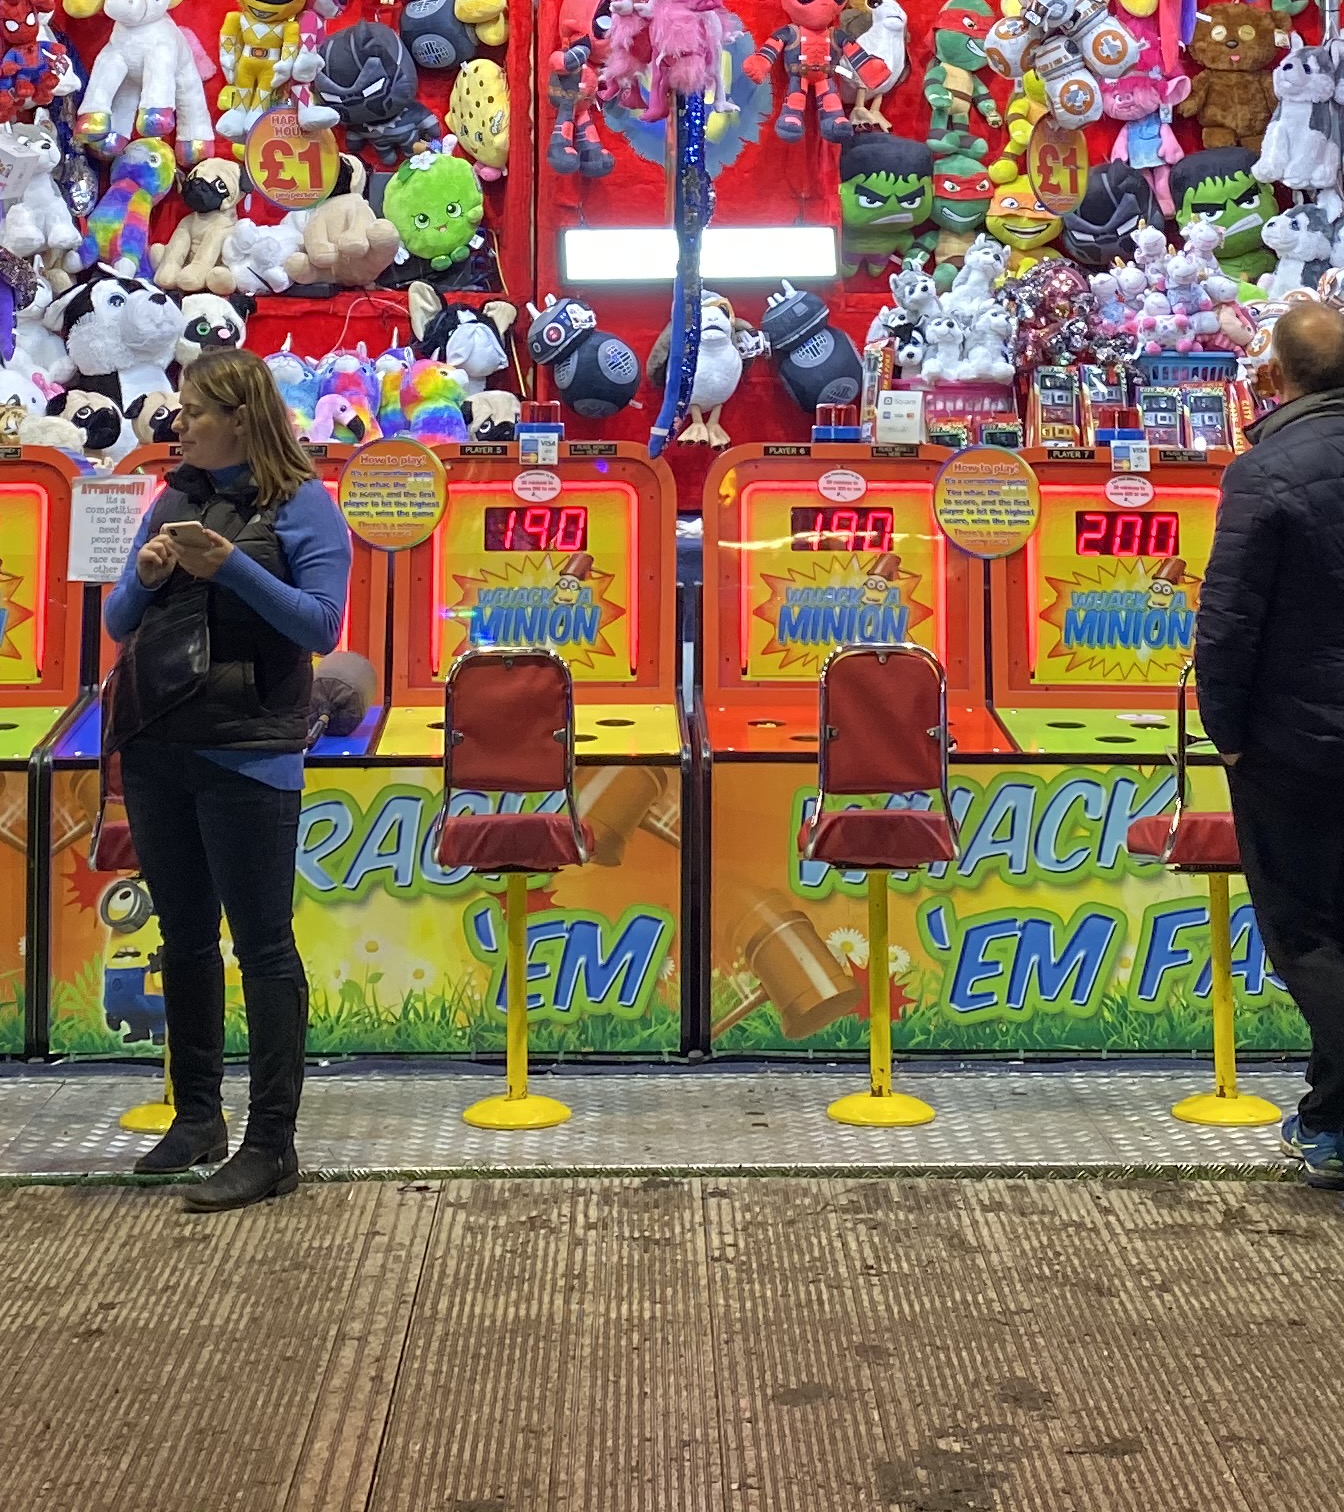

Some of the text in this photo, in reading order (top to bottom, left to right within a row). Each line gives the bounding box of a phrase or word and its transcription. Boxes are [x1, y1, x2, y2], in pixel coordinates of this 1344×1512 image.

[271, 114, 298, 126] HAP
[275, 127, 302, 136] HOU
[259, 138, 323, 191] £1
[1037, 143, 1079, 196] £1
[465, 446, 493, 454] PLAYER
[1052, 450, 1081, 458] PLAYER
[1132, 446, 1147, 454] VISA
[360, 455, 384, 464] How
[385, 455, 398, 464] to
[953, 462, 976, 473] How
[979, 462, 991, 473] to
[85, 506, 141, 515] competition
[124, 516, 136, 524] do
[504, 508, 586, 551] 190
[812, 510, 893, 552] 190
[1078, 514, 1177, 557] 200
[91, 536, 120, 544] people
[120, 546, 129, 554] to
[93, 565, 118, 573] other
[577, 588, 593, 605] A
[786, 586, 901, 605] WHACK A
[1071, 590, 1186, 609] WHACK A
[469, 605, 601, 646] MINION
[778, 605, 910, 644] MINION
[1064, 608, 1195, 649] MINION
[926, 905, 1119, 1013] 'EM
